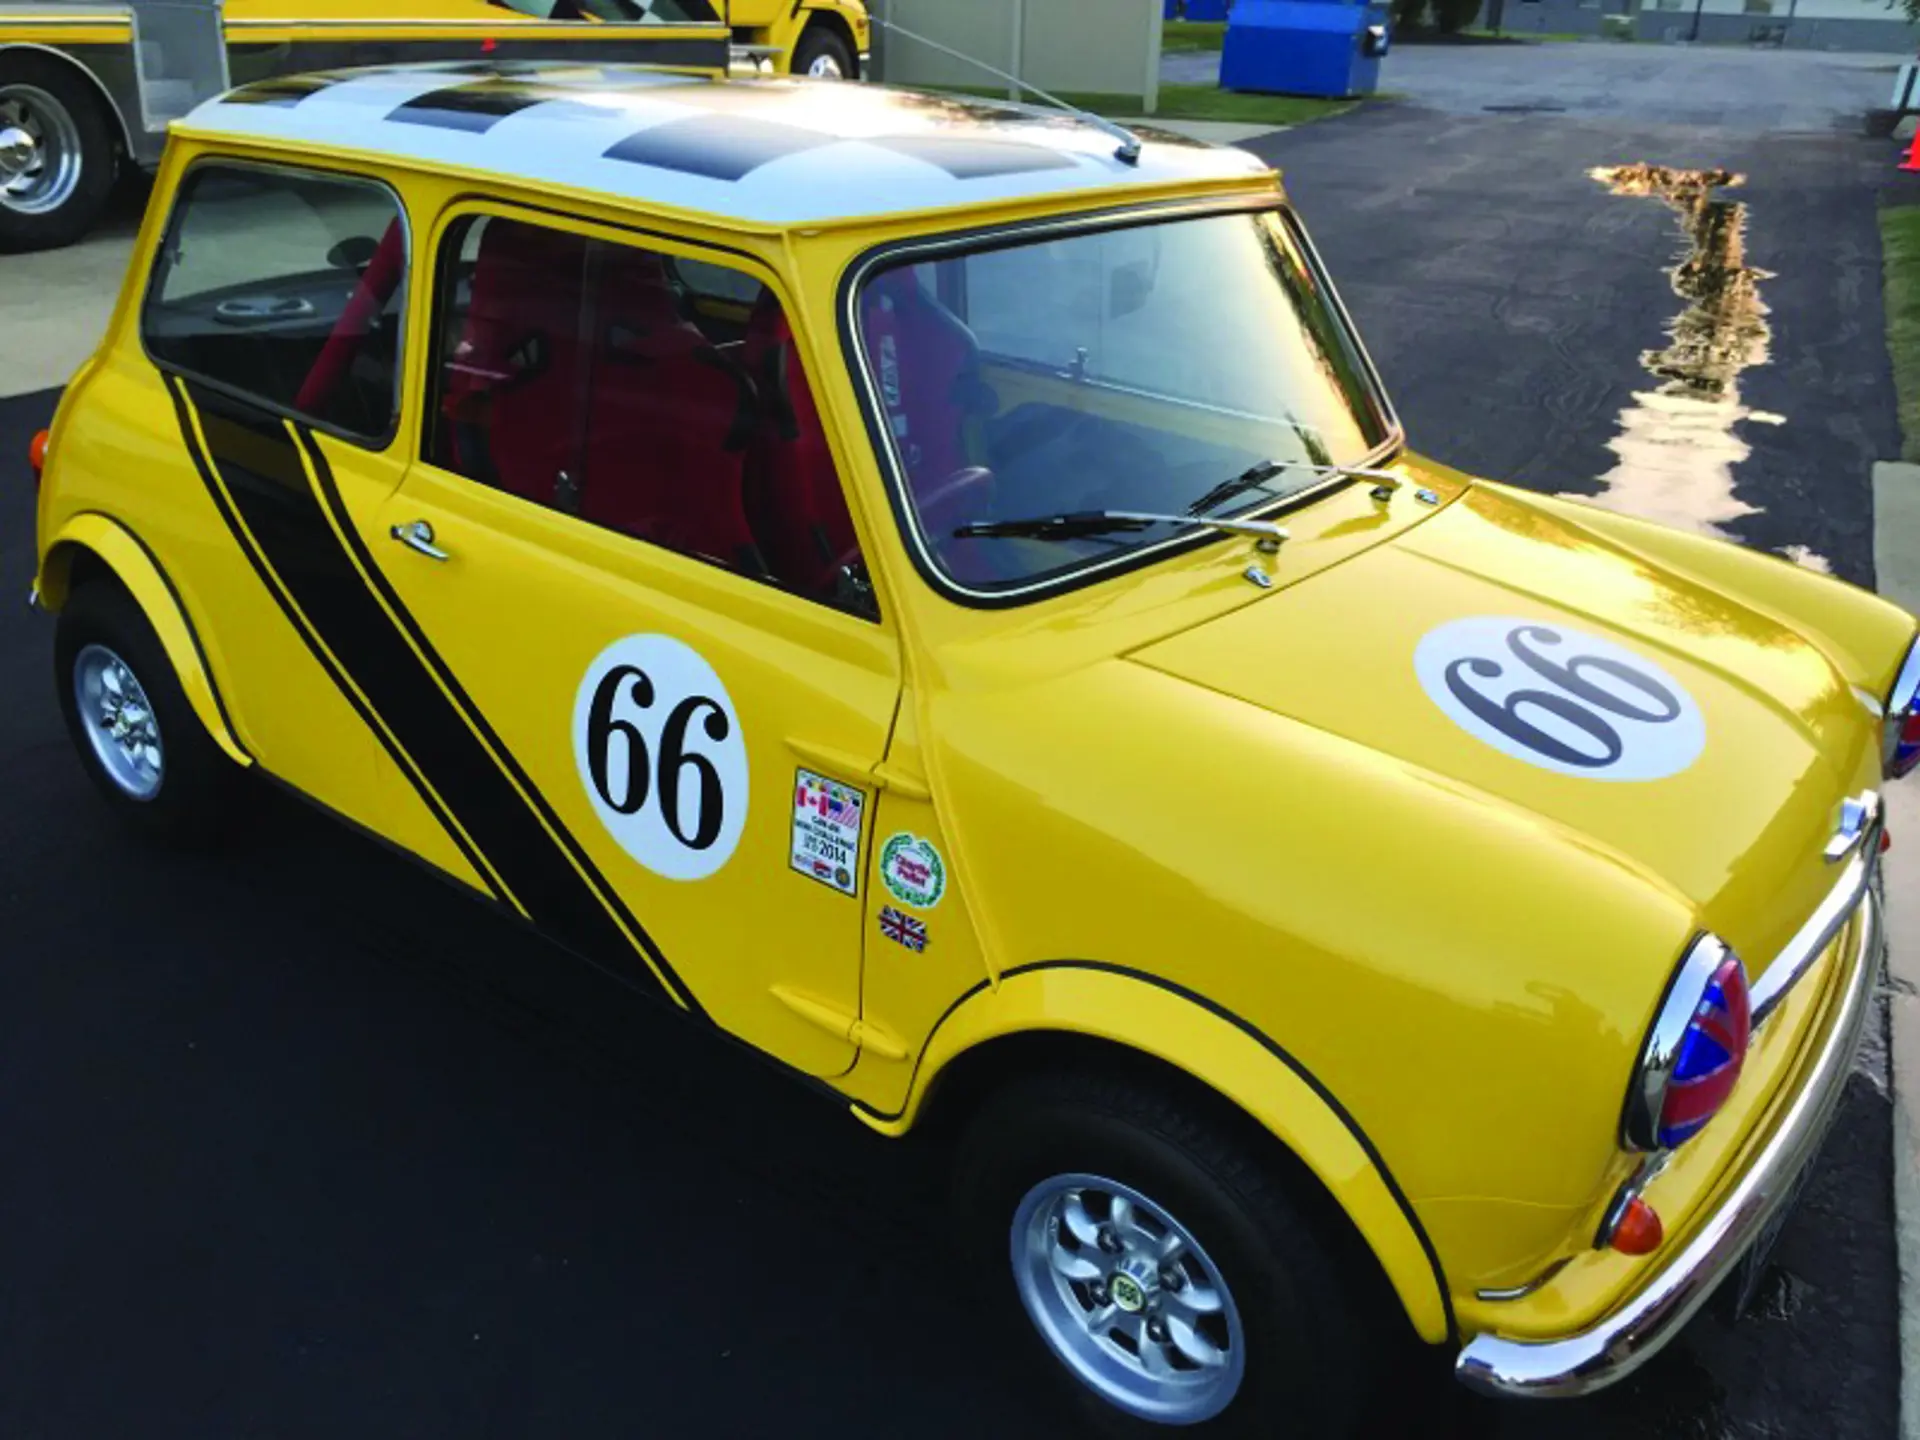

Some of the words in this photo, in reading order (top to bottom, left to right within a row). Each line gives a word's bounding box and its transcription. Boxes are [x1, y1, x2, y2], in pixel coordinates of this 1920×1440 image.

[588, 664, 729, 850] 66
[1444, 625, 1681, 768] 66
[819, 840, 846, 864] 2014
